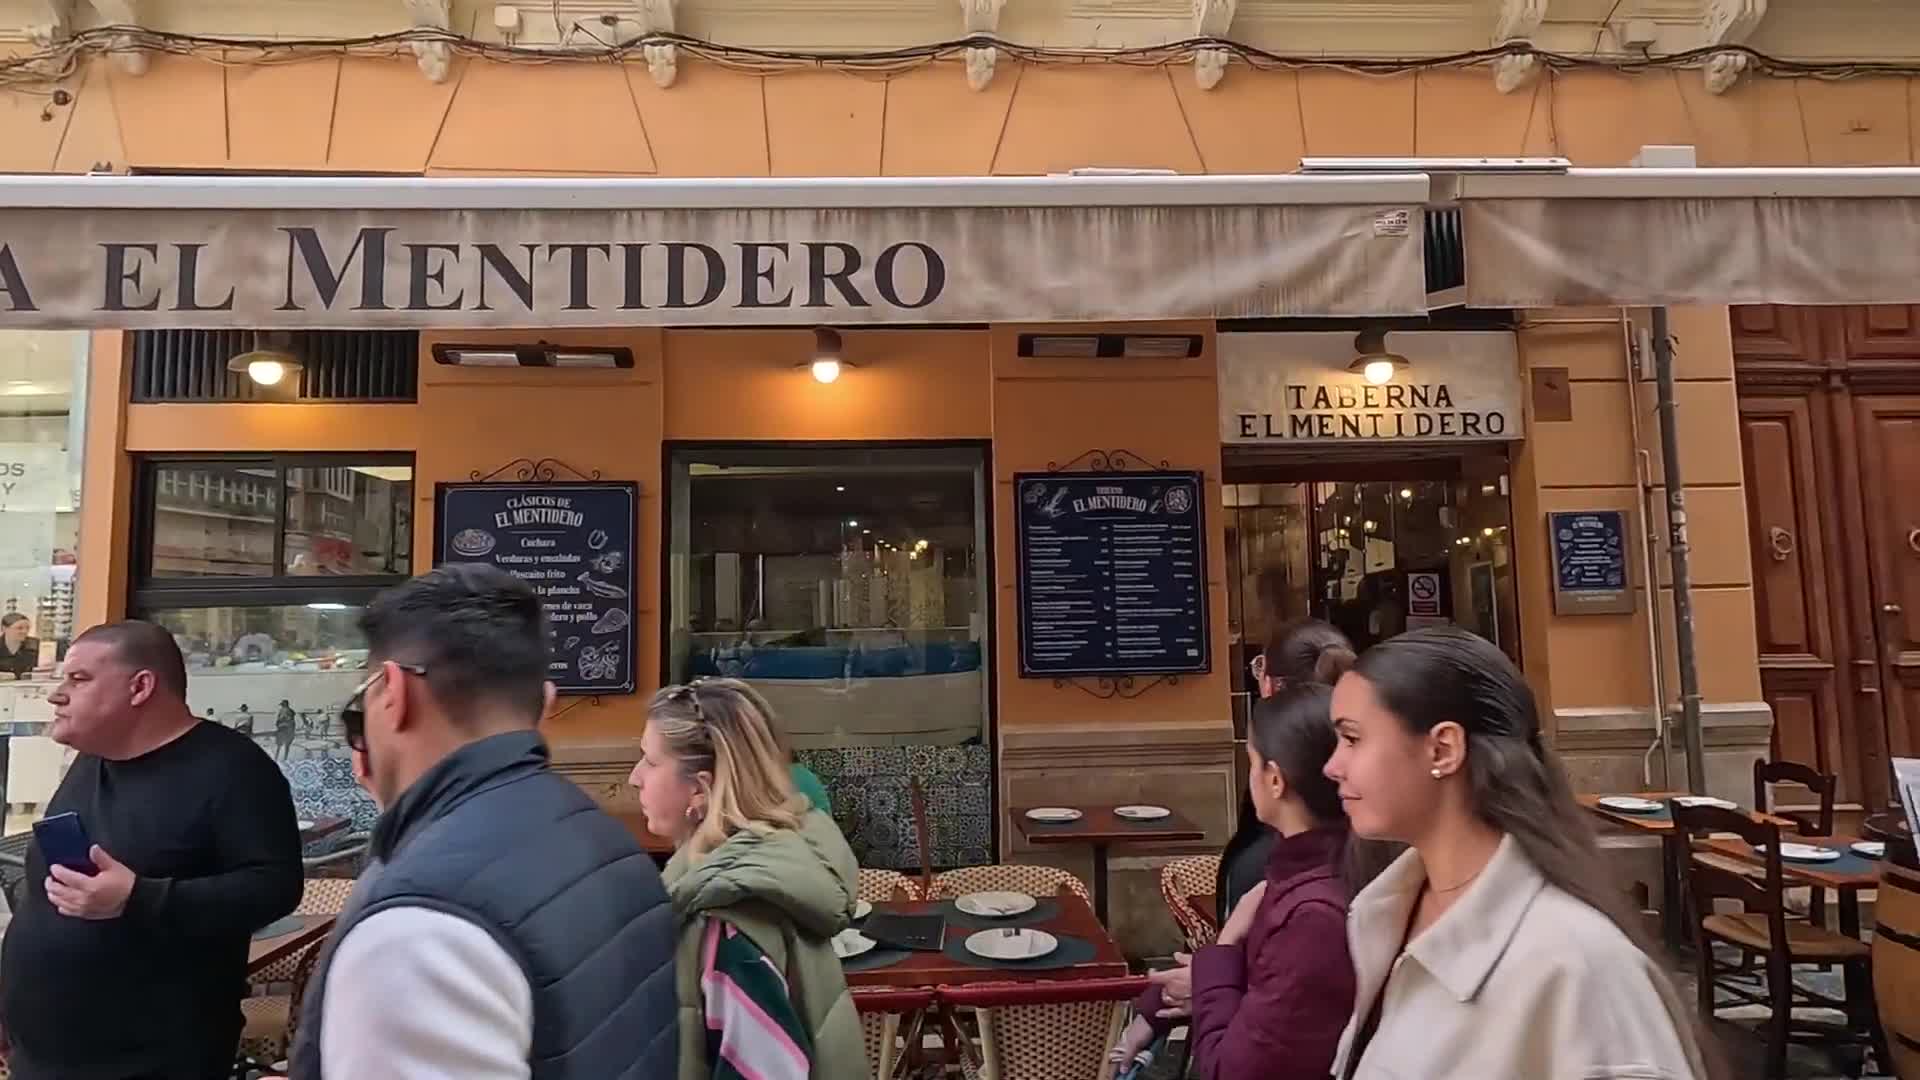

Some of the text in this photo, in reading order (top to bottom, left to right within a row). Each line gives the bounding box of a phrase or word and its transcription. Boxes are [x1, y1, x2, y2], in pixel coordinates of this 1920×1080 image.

[98, 243, 235, 312] EL
[1288, 384, 1454, 409] TABERNA
[1239, 411, 1505, 438] EL MENTIDERO
[506, 493, 572, 509] CLÁSICOS DE
[1073, 495, 1147, 513] EL MENTIDERO
[495, 508, 584, 528] EL MENTIDERO
[520, 537, 556, 548] Cuchara
[495, 553, 581, 565] Verduras y ensaladas
[546, 568, 567, 578] frito
[538, 585, 547, 595] la
[547, 585, 581, 597] plancha
[562, 601, 572, 610] de
[573, 602, 593, 610] vaca
[569, 614, 575, 623] y
[576, 612, 598, 622] pollo
